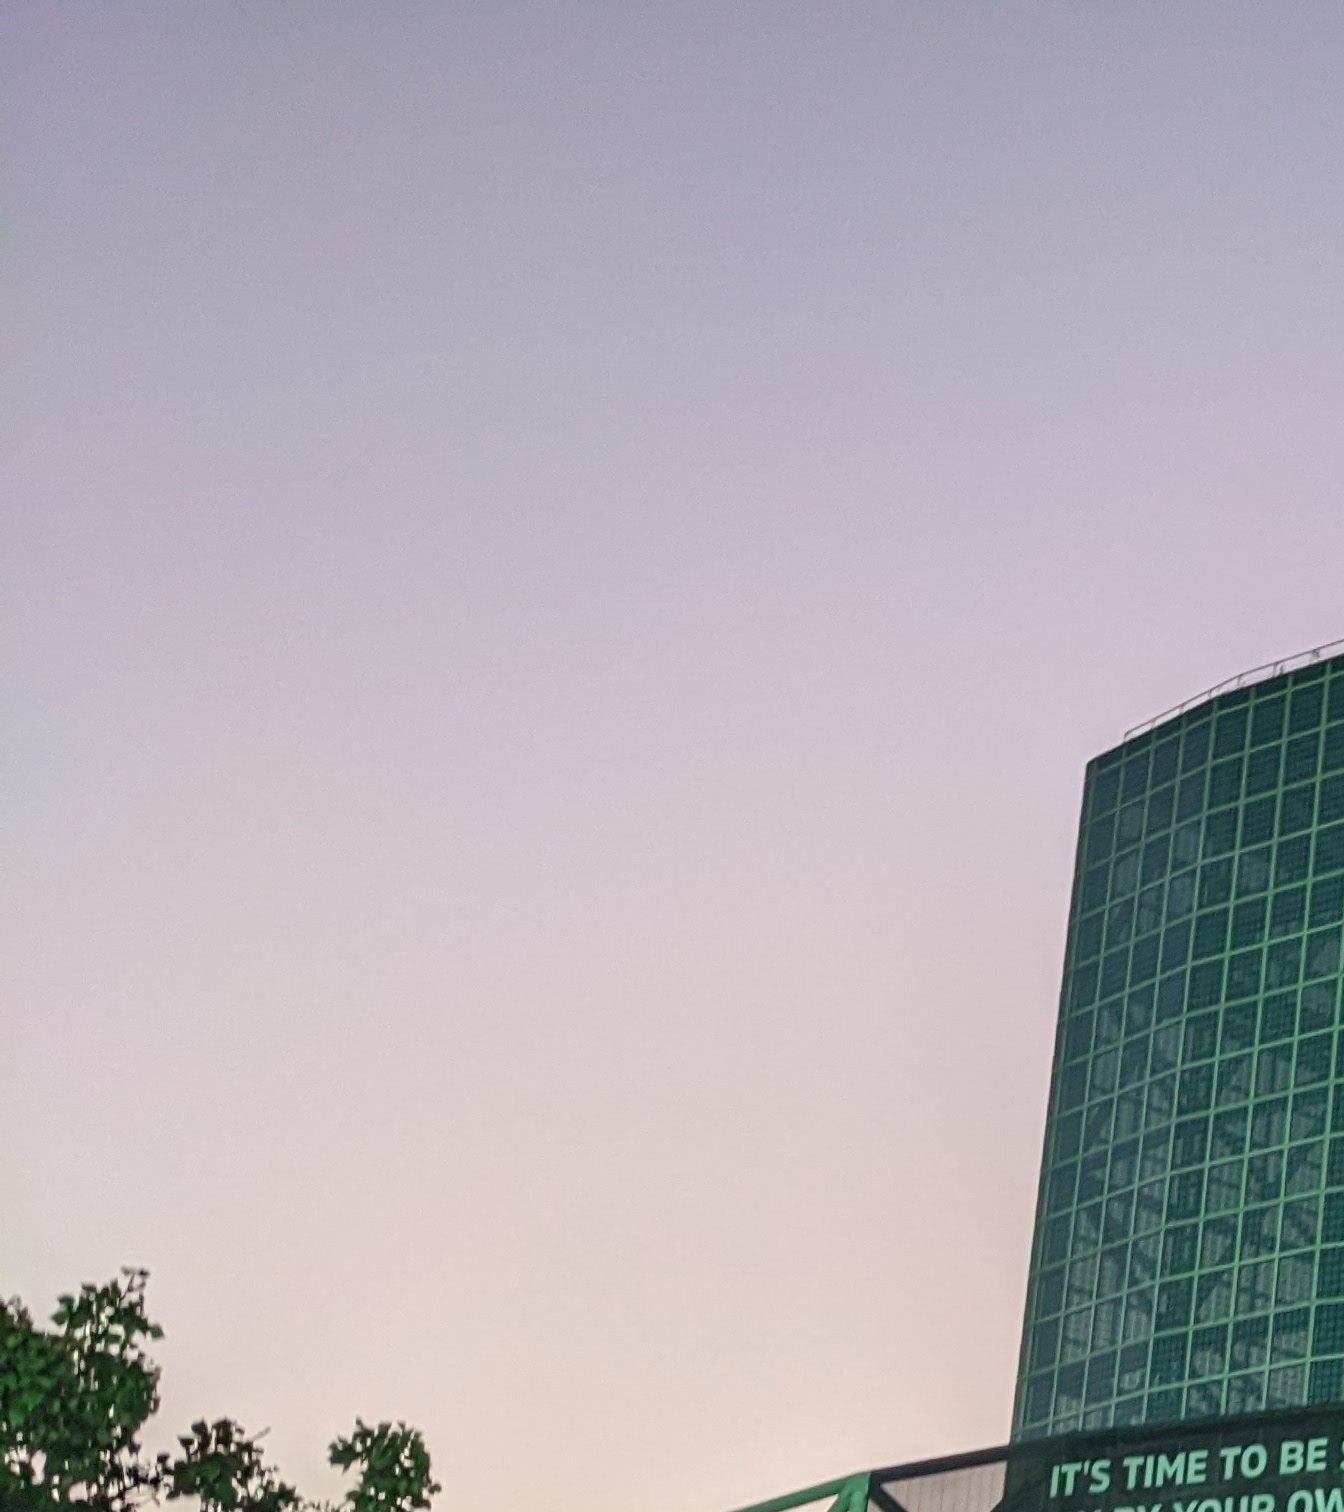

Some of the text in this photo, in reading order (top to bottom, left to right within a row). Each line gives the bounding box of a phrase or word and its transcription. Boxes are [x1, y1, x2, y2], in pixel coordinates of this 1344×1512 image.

[1050, 1459, 1112, 1498] IT'S
[1123, 1451, 1208, 1491] TIME
[1220, 1445, 1267, 1480] TO
[1279, 1439, 1329, 1475] BE
